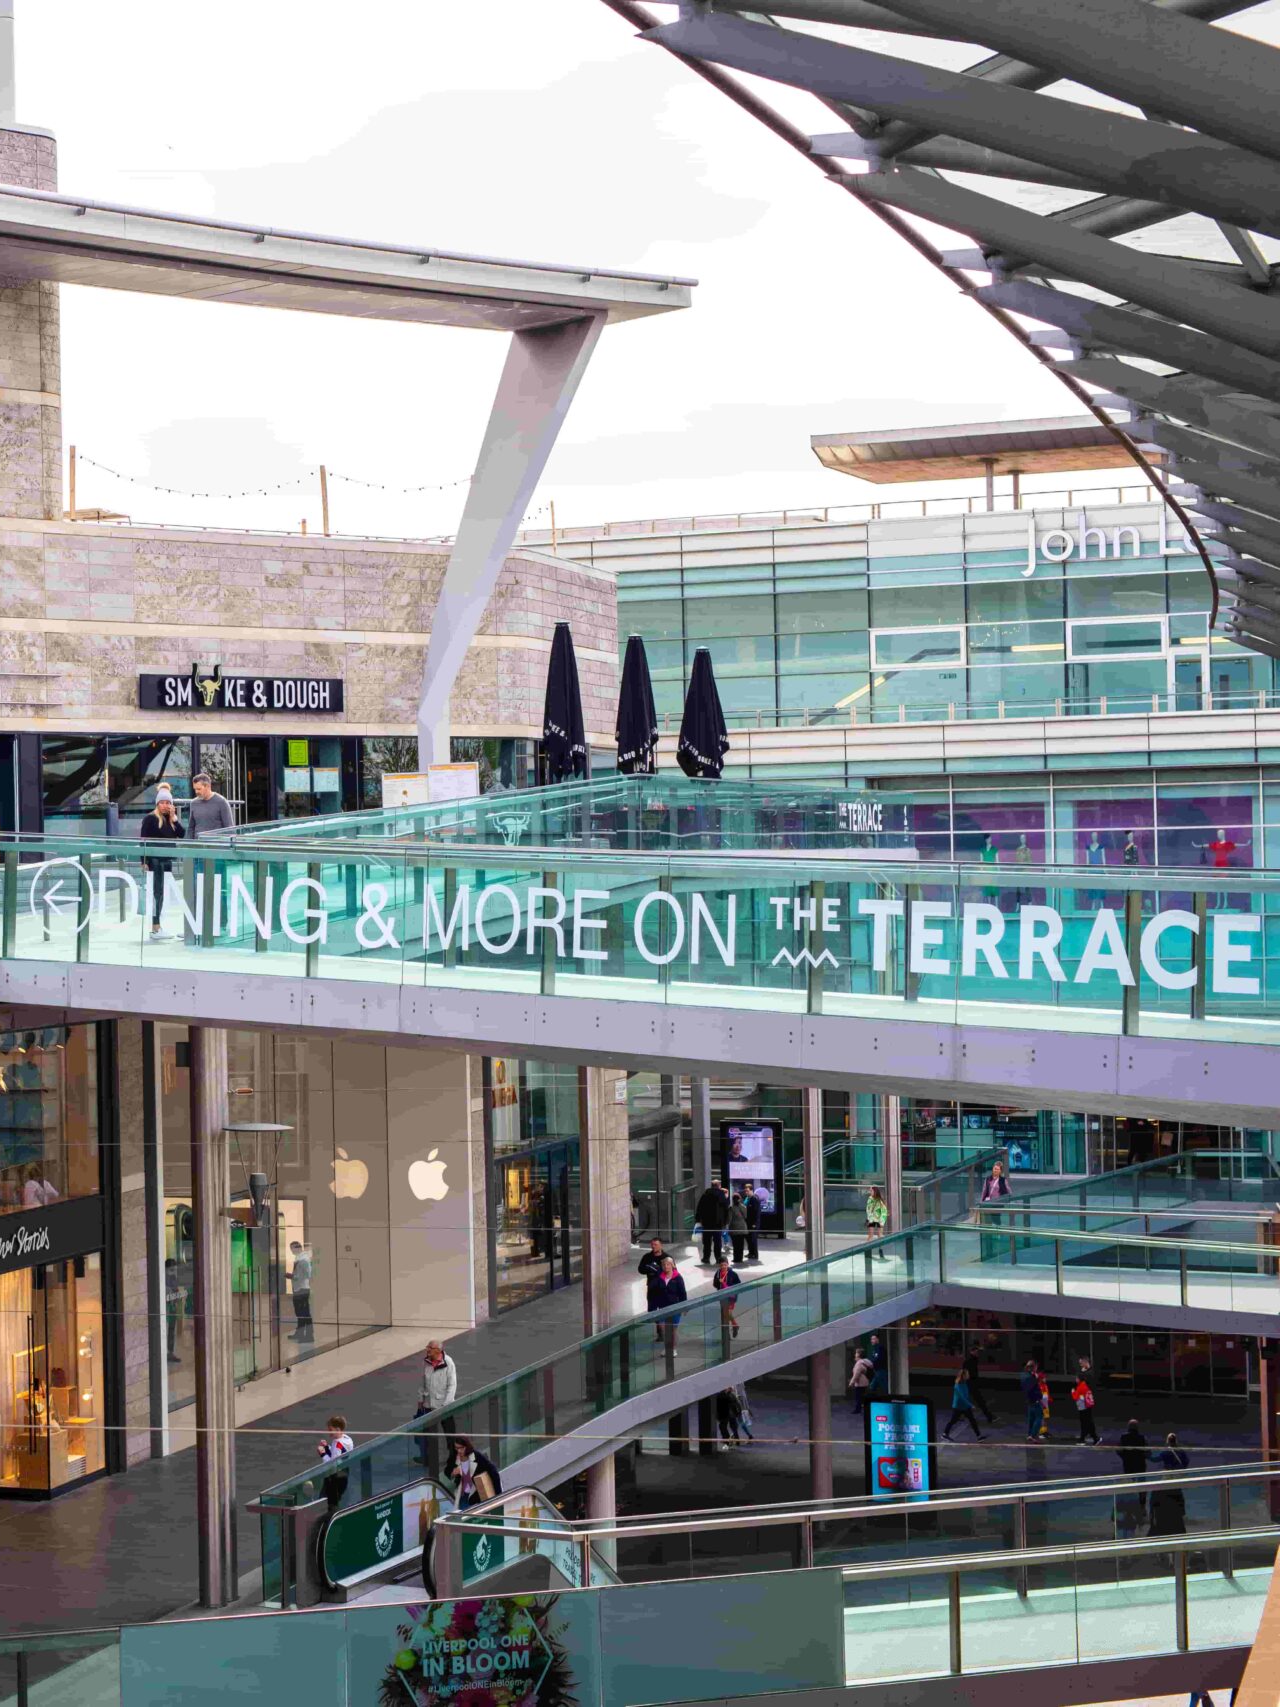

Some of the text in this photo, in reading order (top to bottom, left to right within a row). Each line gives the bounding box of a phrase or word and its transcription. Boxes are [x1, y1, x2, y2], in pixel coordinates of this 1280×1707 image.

[165, 677, 330, 709] SMKE & DOUGH
[848, 803, 883, 831] TERRACE
[98, 869, 1261, 995] DINING & MORE ON THE TERRACE
[17, 1226, 50, 1256] Stories
[884, 1432, 915, 1442] PROF
[422, 1634, 530, 1655] LIVERPOOL ONE
[423, 1650, 530, 1677] IN BLOOM
